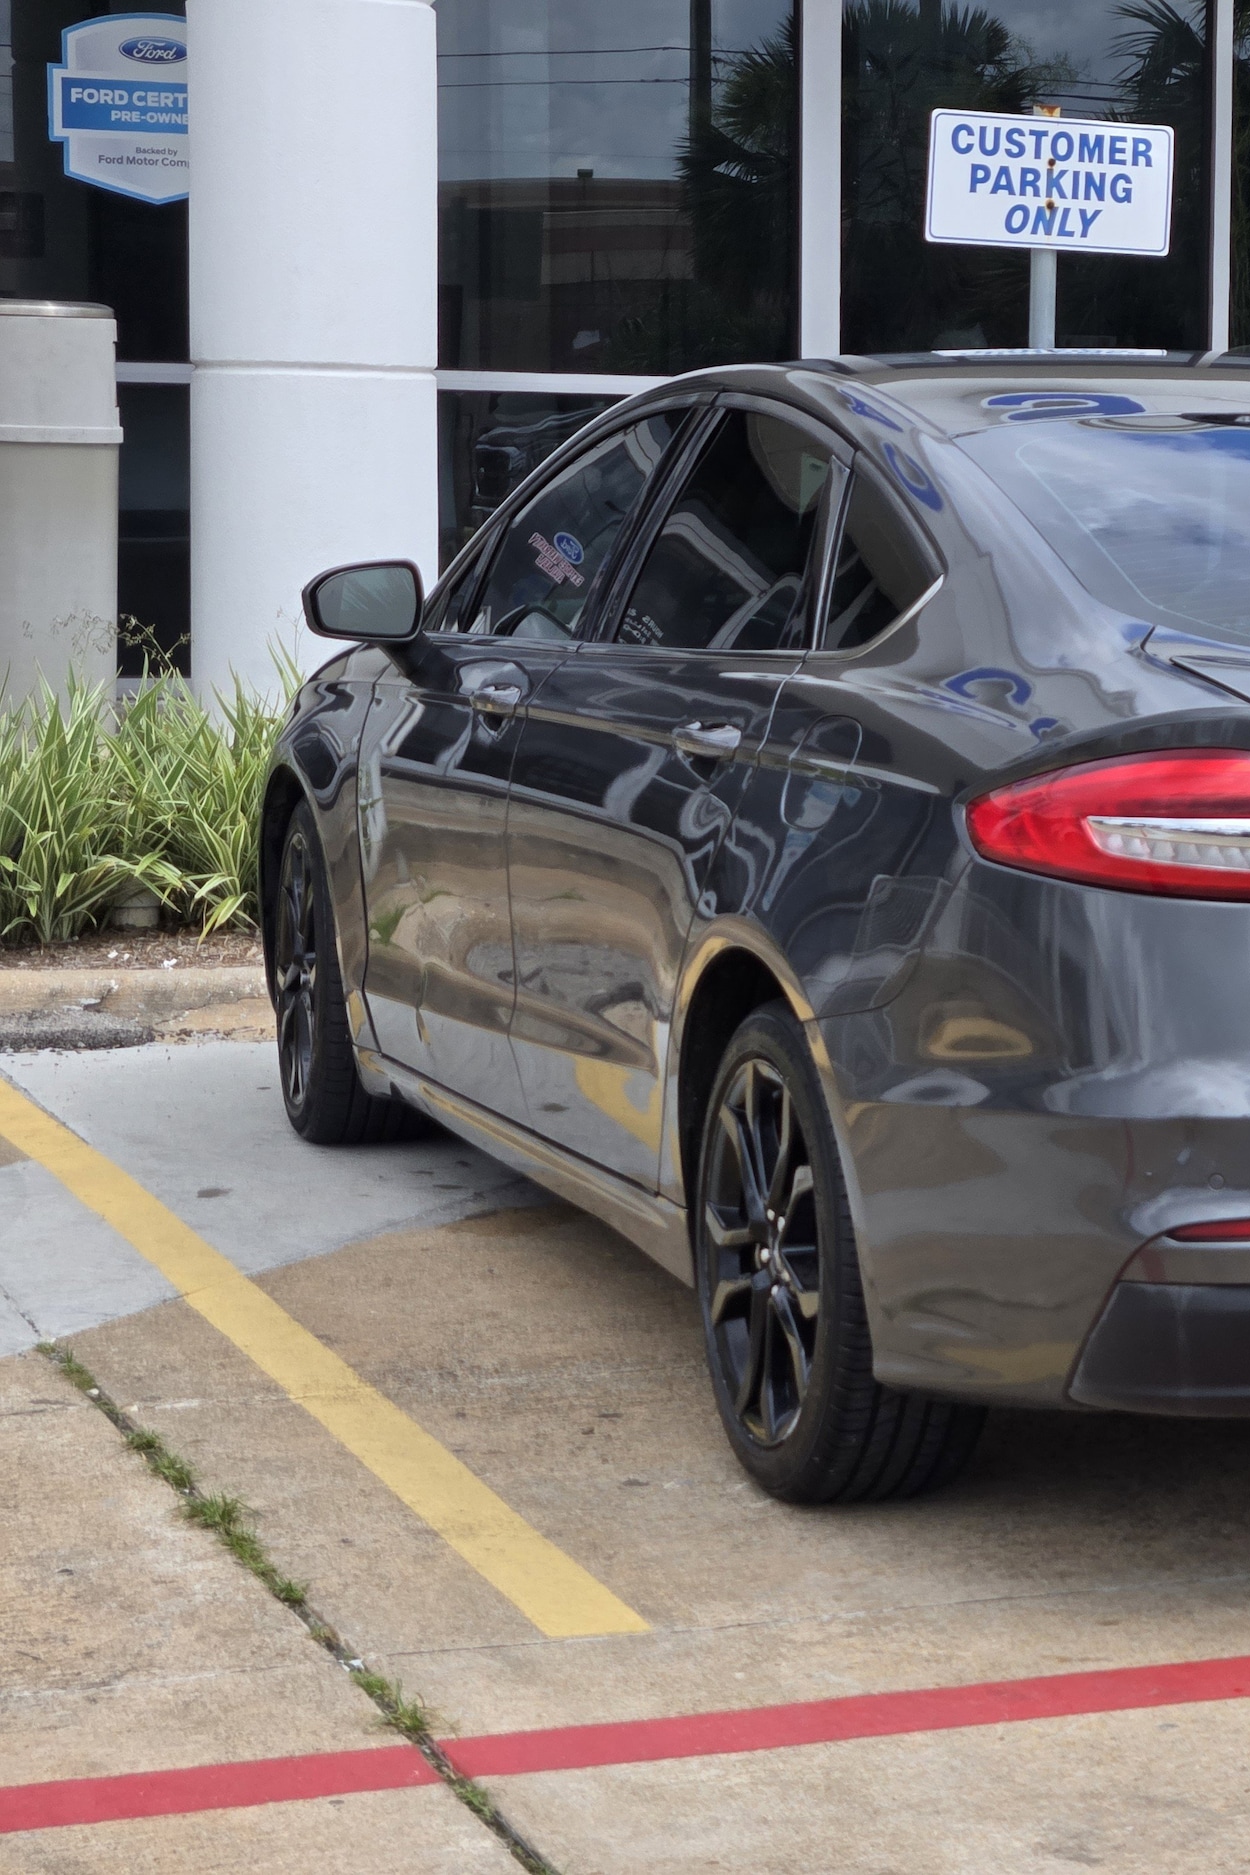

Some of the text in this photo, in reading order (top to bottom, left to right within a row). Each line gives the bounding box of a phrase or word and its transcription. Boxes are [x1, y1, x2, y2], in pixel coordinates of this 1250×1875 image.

[132, 40, 177, 60] Ford
[70, 87, 129, 105] FORD
[135, 146, 178, 156] Backed by
[951, 123, 1153, 167] CUSTOMER
[98, 155, 124, 165] Ford
[126, 156, 159, 166] Motor
[969, 163, 1133, 204] PARKING
[1004, 204, 1103, 238] ONLY
